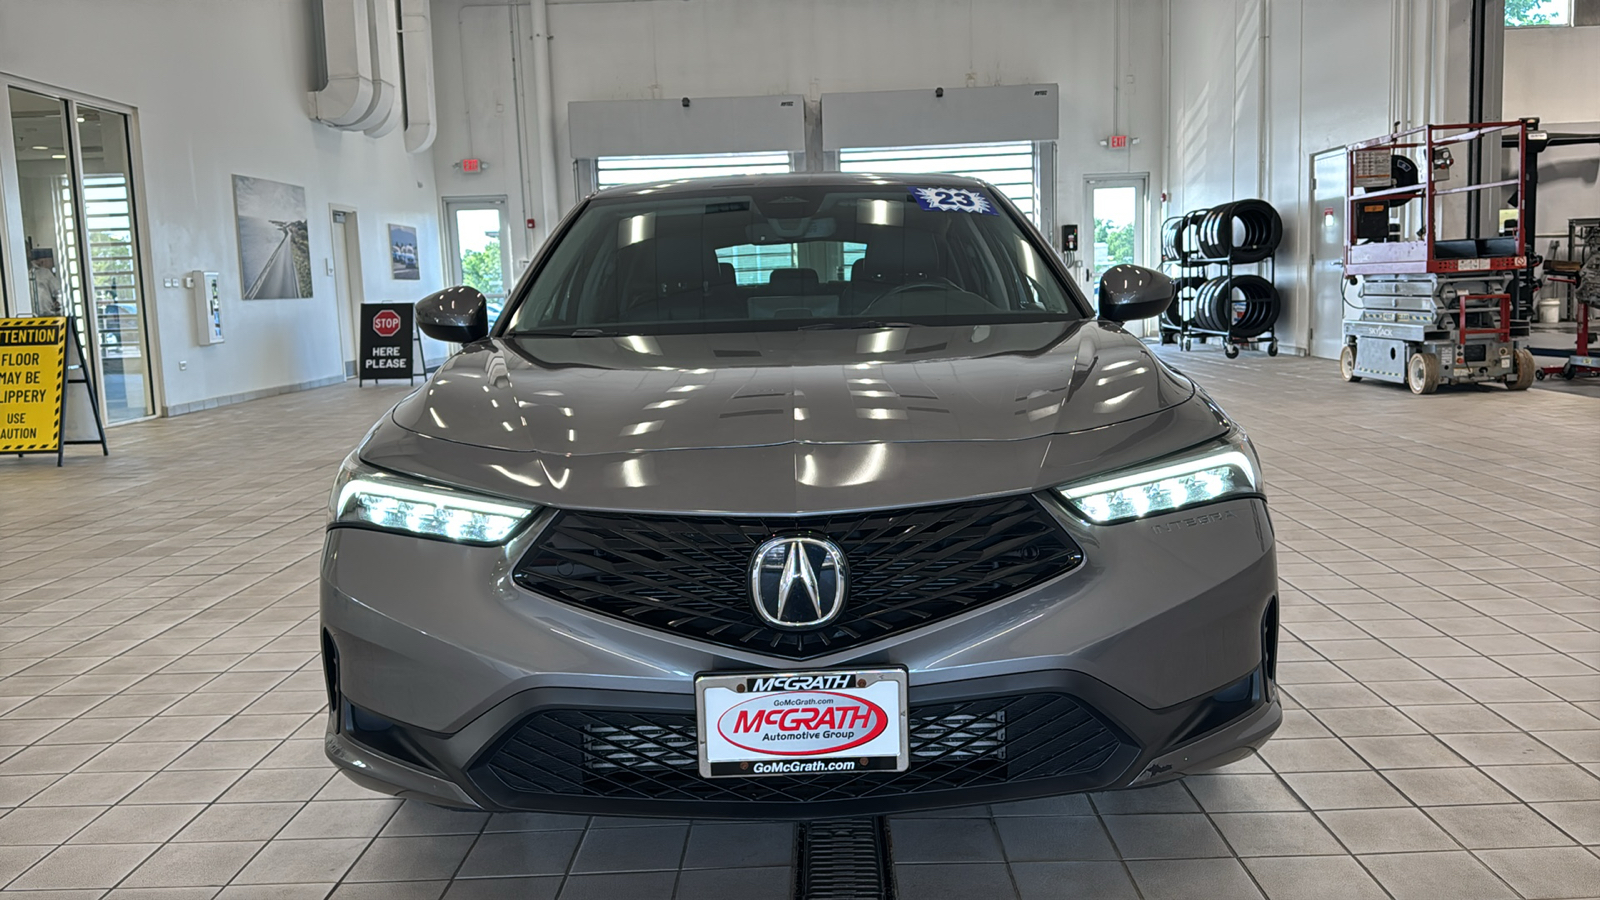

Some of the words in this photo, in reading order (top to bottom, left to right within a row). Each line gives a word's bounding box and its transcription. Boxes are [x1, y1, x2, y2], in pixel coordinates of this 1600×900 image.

[1111, 135, 1127, 148] EXIT
[934, 191, 975, 207] 23
[375, 318, 399, 328] STOP
[372, 346, 401, 357] HERE
[1, 353, 39, 366] FLOOR
[365, 358, 407, 369] PLEASE
[25, 370, 41, 384] BE
[7, 412, 27, 425] USE
[1151, 510, 1238, 534] INTEGRA
[773, 697, 834, 707] GoMcGrath.com
[761, 731, 820, 742] Automotive
[822, 730, 855, 740] Group
[753, 760, 856, 774] GoMcGrath.com
